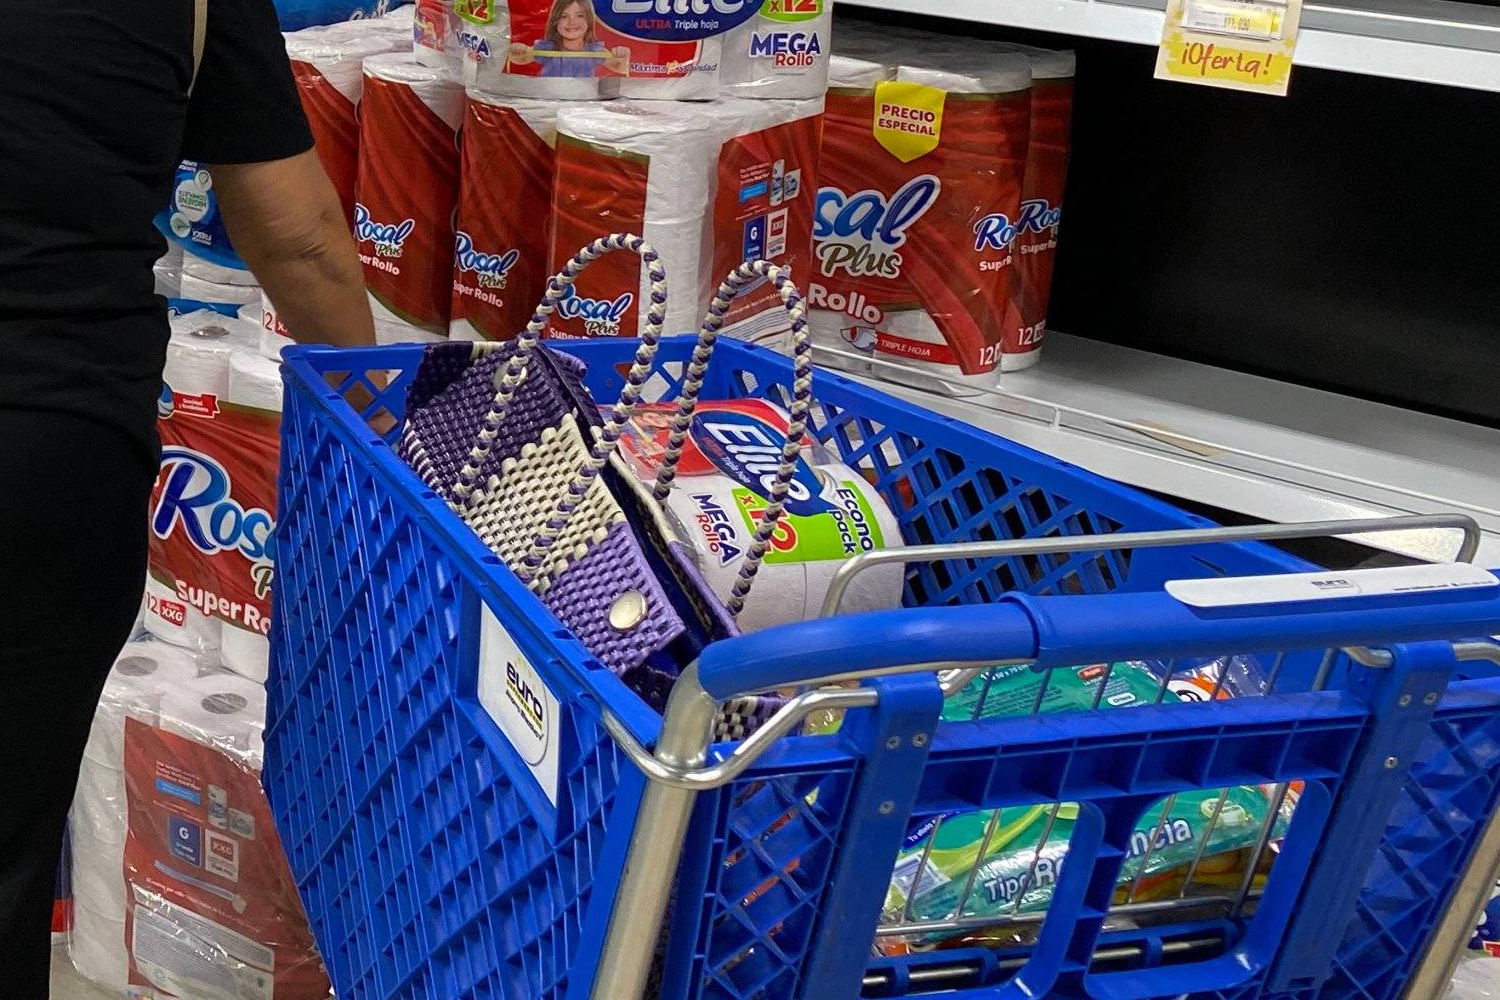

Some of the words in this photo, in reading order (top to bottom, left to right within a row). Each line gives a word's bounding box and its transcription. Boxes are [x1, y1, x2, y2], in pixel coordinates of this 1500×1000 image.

[636, 20, 670, 28] ULTRA
[675, 19, 698, 29] Triple
[700, 19, 719, 30] hoja
[750, 33, 821, 56] MEGA
[775, 53, 813, 67] Rollo
[1181, 42, 1273, 78] ¡Oferta!
[881, 104, 936, 123] PRECIO
[878, 117, 936, 137] ESPECIAL
[814, 174, 941, 246] sal
[375, 243, 402, 257] Plus
[454, 230, 520, 276] Rosal
[817, 242, 903, 279] Plus
[372, 258, 400, 276] Rollo
[478, 274, 506, 289] Plus
[474, 287, 504, 308] Rollo
[809, 283, 883, 325] Rollo
[585, 320, 619, 335] Plus
[1018, 326, 1033, 345] 12
[881, 339, 906, 353] TRIPLE
[907, 346, 931, 358] HOJA
[692, 493, 742, 565] MEGA
[837, 488, 874, 551] Econo
[828, 509, 856, 553] pack
[175, 579, 242, 620] Super
[161, 606, 184, 623] XXG
[506, 661, 543, 721] euro
[179, 826, 190, 841] G
[983, 873, 1030, 902] Tipo
